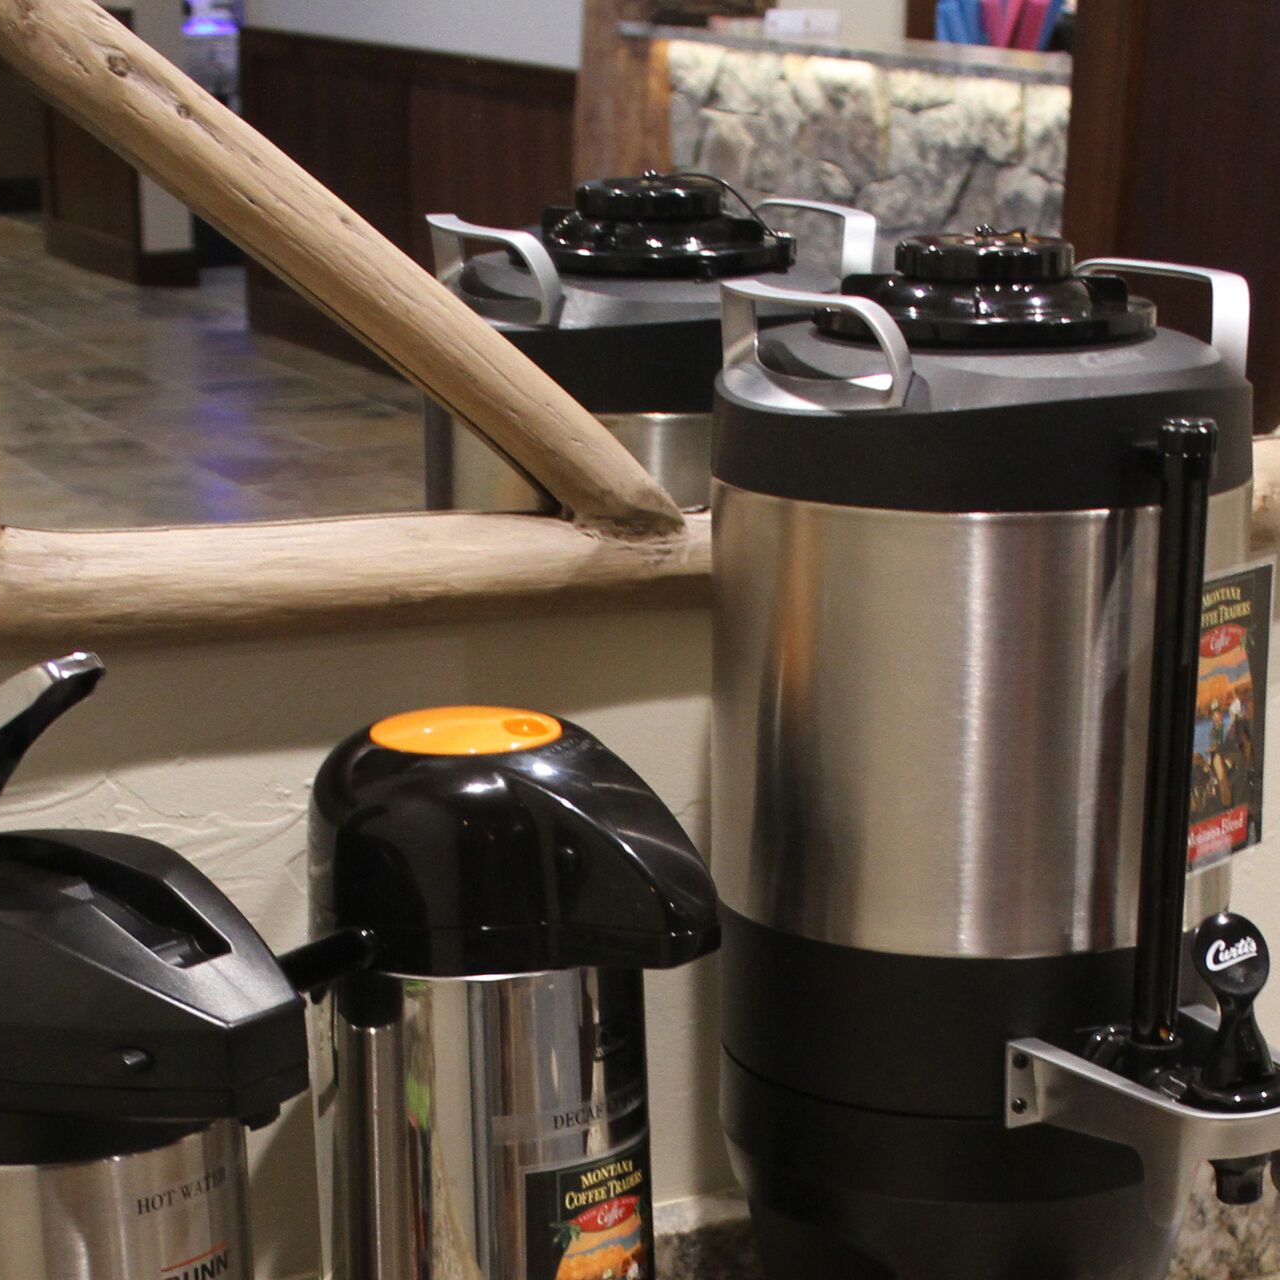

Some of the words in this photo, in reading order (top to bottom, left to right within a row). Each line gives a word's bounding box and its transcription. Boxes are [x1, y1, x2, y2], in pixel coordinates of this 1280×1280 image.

[1206, 935, 1258, 972] Curtis
[565, 1187, 607, 1210] COFFEE
[607, 1169, 643, 1198] TRADERS
[580, 1160, 633, 1188] MONTANA
[136, 1189, 175, 1215] HOT
